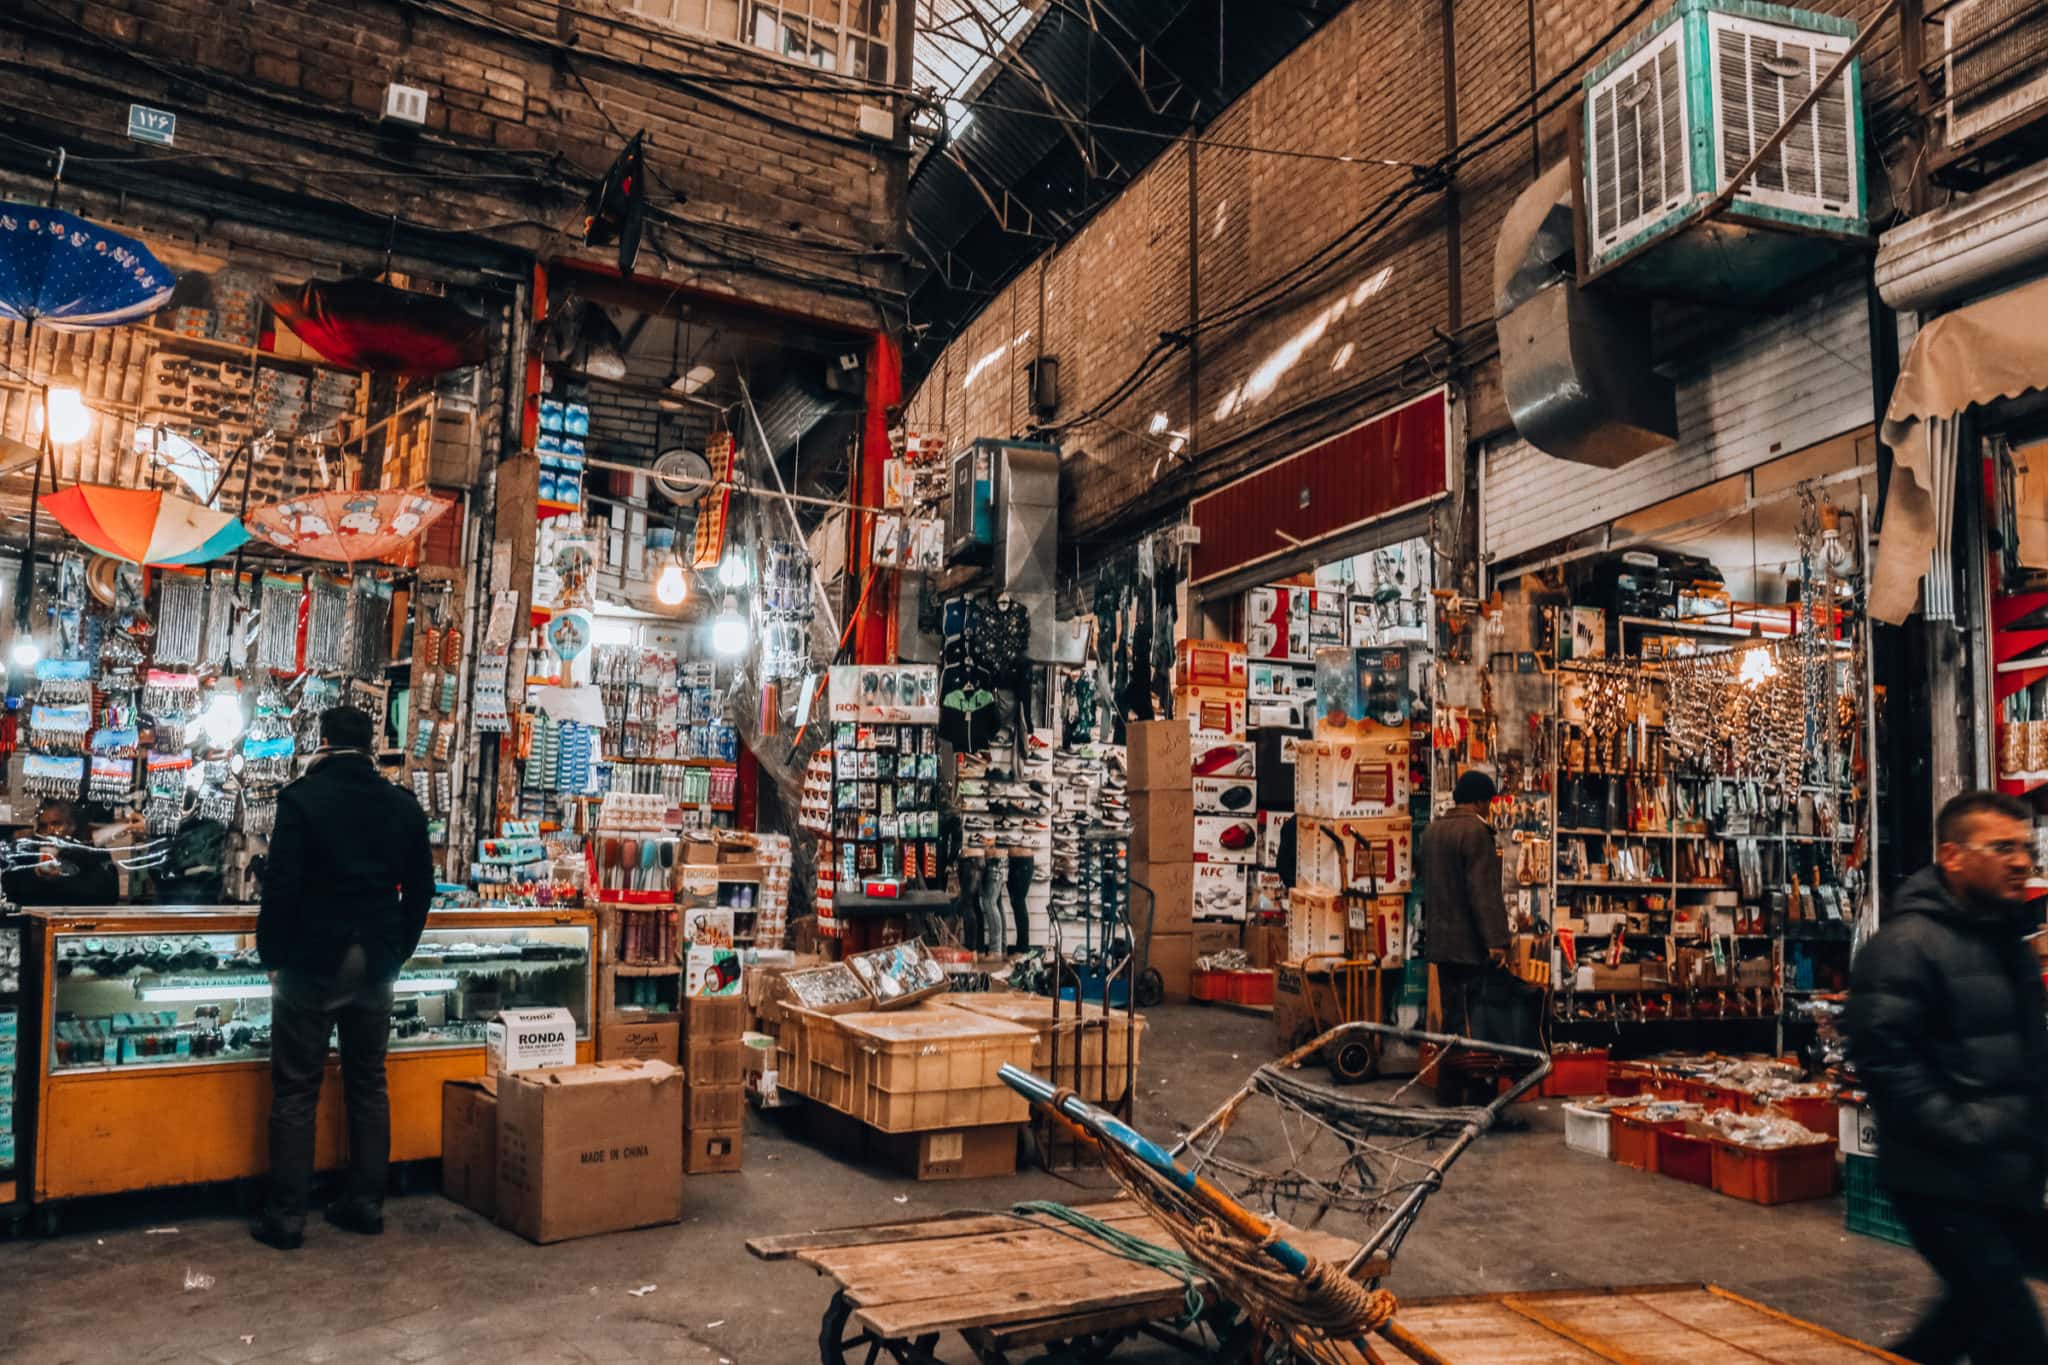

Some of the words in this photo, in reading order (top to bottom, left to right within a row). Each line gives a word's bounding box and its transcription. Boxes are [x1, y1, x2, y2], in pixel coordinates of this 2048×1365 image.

[1200, 866, 1223, 877] KFC
[519, 1032, 565, 1044] RONDA
[581, 1151, 604, 1163] MADE
[610, 1149, 619, 1161] IN
[623, 1145, 648, 1159] CHINA
